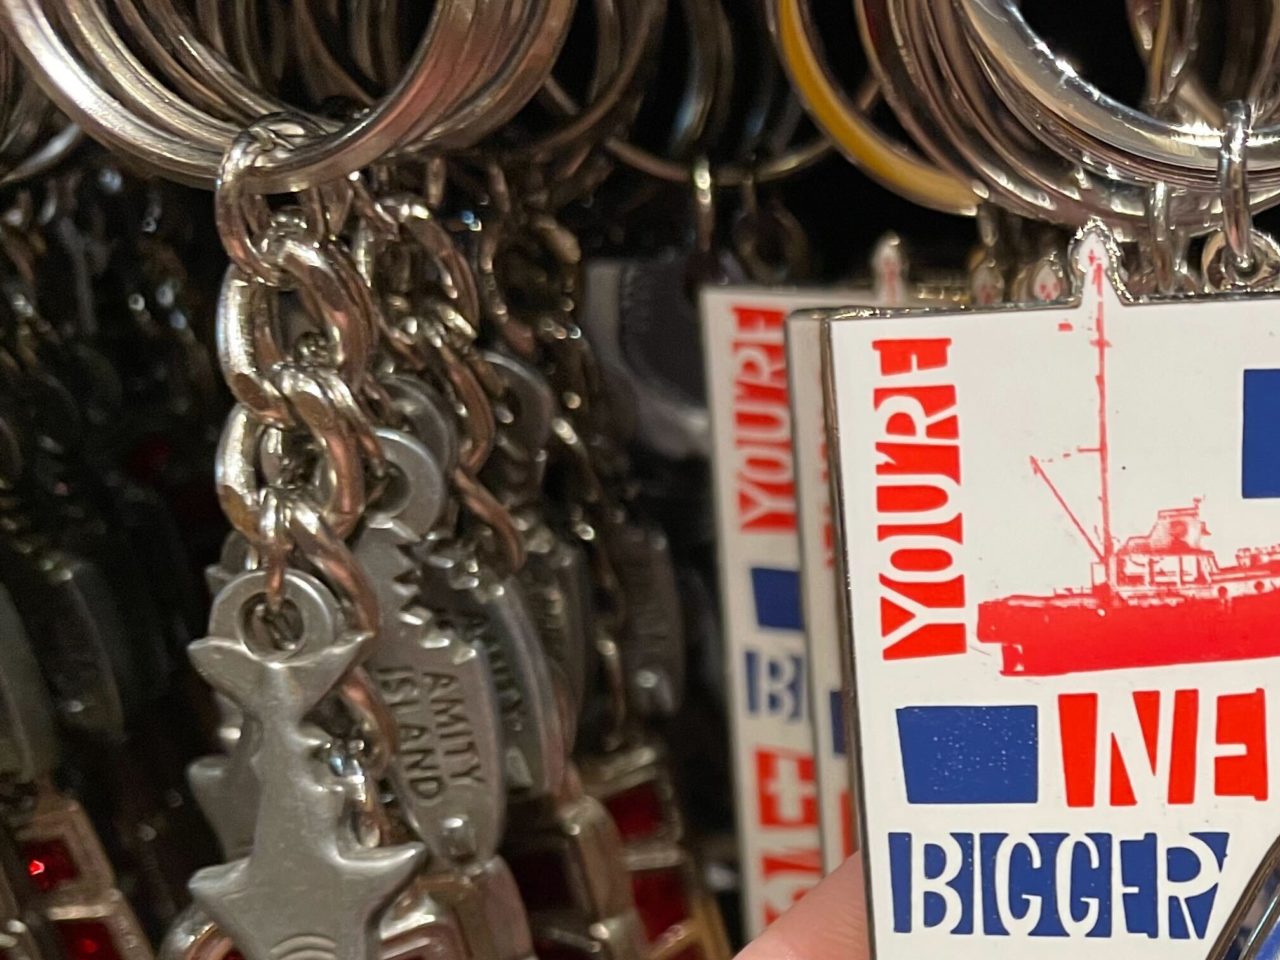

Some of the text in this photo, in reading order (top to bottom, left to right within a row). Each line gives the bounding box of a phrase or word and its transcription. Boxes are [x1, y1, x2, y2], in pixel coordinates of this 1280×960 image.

[375, 665, 446, 800] ISLAND
[421, 671, 485, 787] AMITY
[898, 832, 1226, 939] BIGGER
